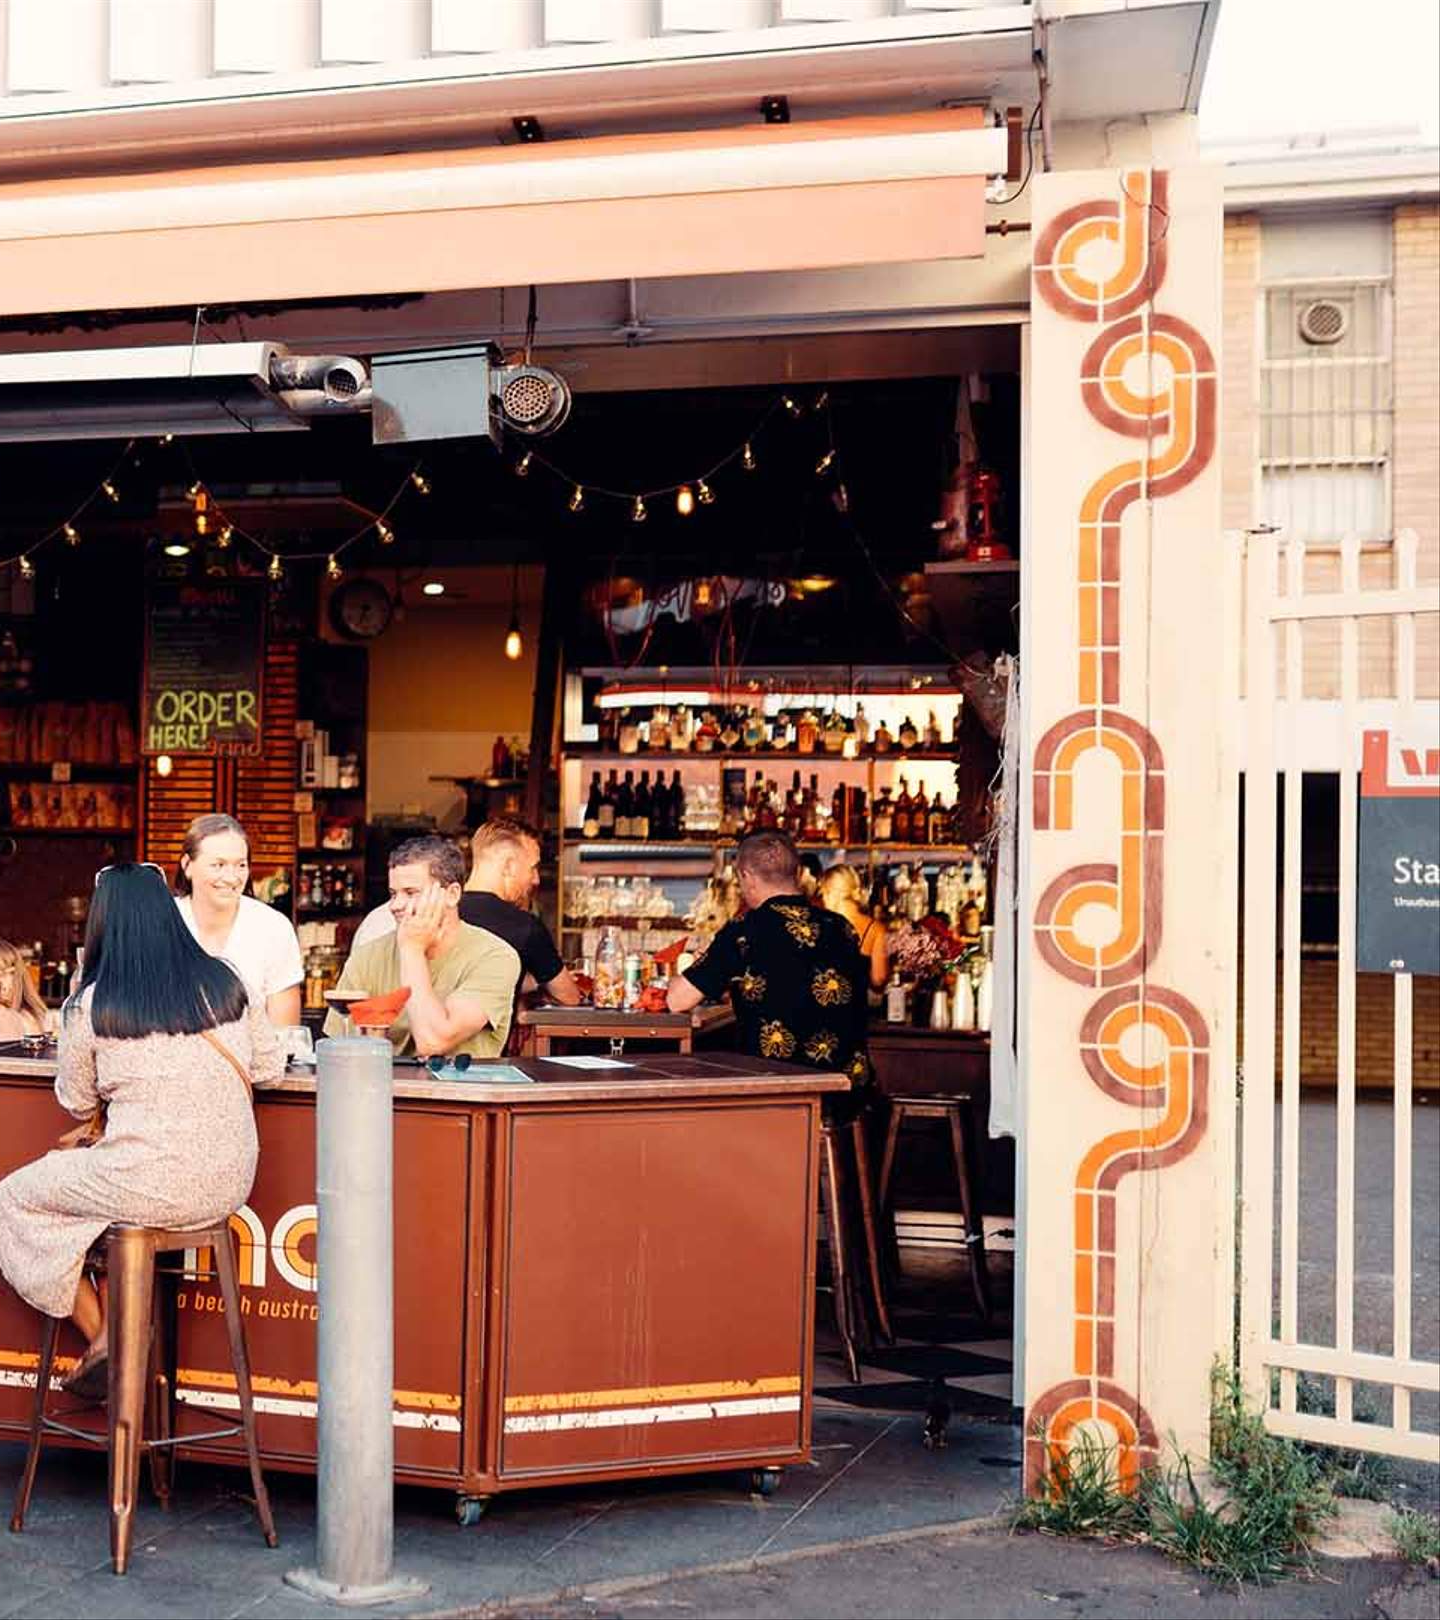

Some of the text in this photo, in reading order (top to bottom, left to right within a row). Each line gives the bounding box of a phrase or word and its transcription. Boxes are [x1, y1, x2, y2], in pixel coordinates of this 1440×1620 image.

[156, 690, 257, 728] ORDER
[149, 723, 208, 750] HERE!
[1393, 857, 1440, 885] Sta
[194, 1292, 251, 1315] beah
